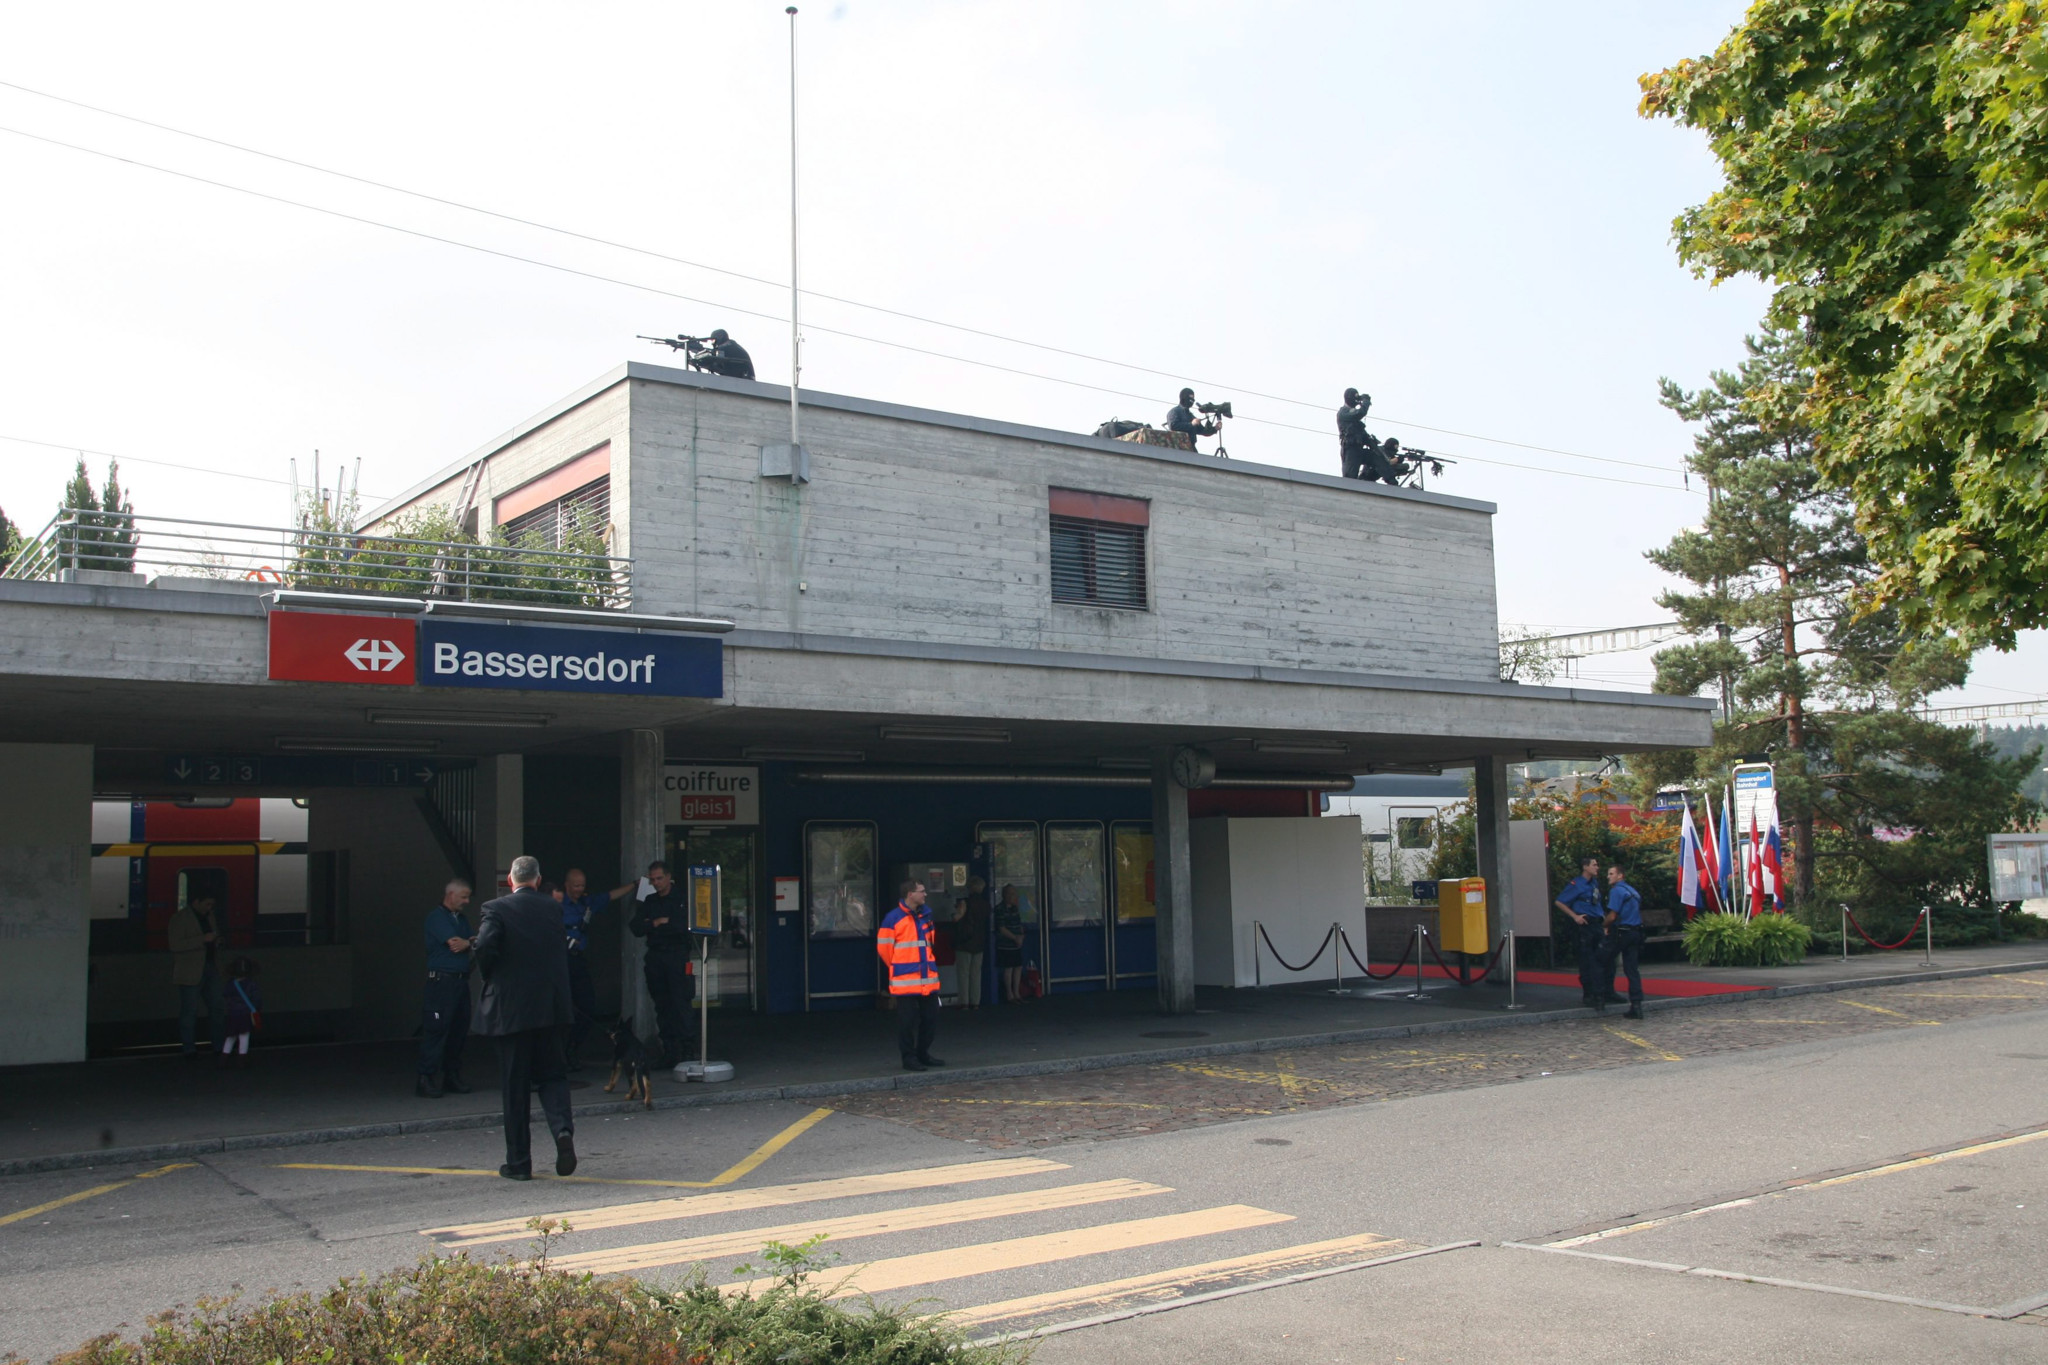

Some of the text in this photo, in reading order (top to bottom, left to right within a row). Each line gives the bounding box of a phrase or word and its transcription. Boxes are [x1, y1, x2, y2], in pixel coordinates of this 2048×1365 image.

[434, 642, 655, 684] Bassersdorf
[208, 765, 253, 781] 2 3
[392, 767, 399, 782] 1
[664, 771, 751, 792] coiffure
[684, 799, 733, 818] gleis1
[132, 858, 141, 875] 1
